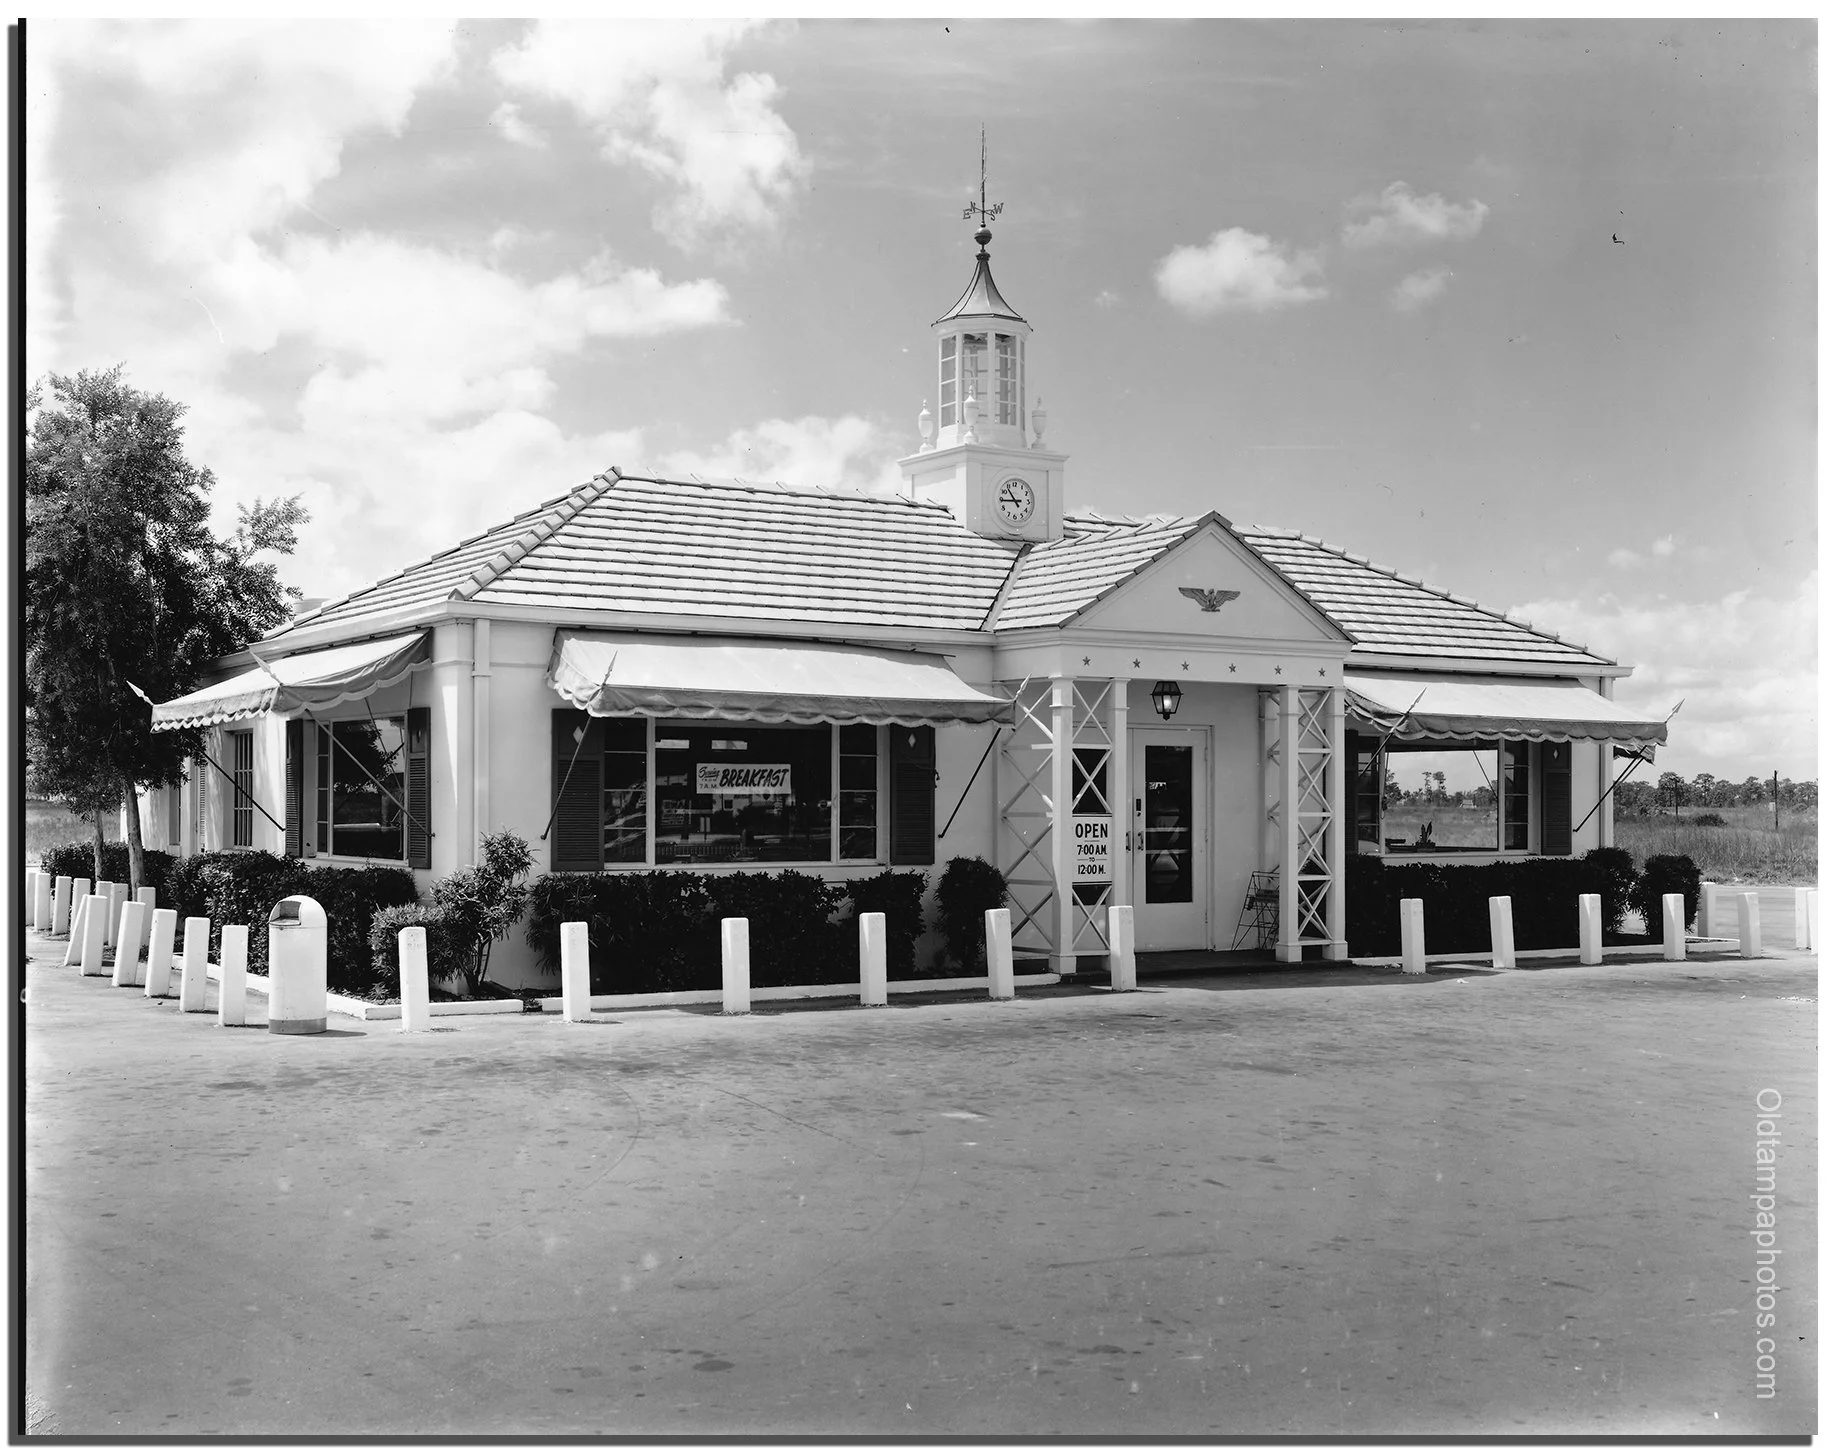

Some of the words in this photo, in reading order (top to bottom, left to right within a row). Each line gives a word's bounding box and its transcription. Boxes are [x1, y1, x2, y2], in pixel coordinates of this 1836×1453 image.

[963, 209, 971, 220] E
[719, 768, 790, 788] BREAKFAST
[1075, 823, 1108, 838] OPEN
[1077, 844, 1095, 855] 7:00
[1078, 864, 1097, 875] 12:00
